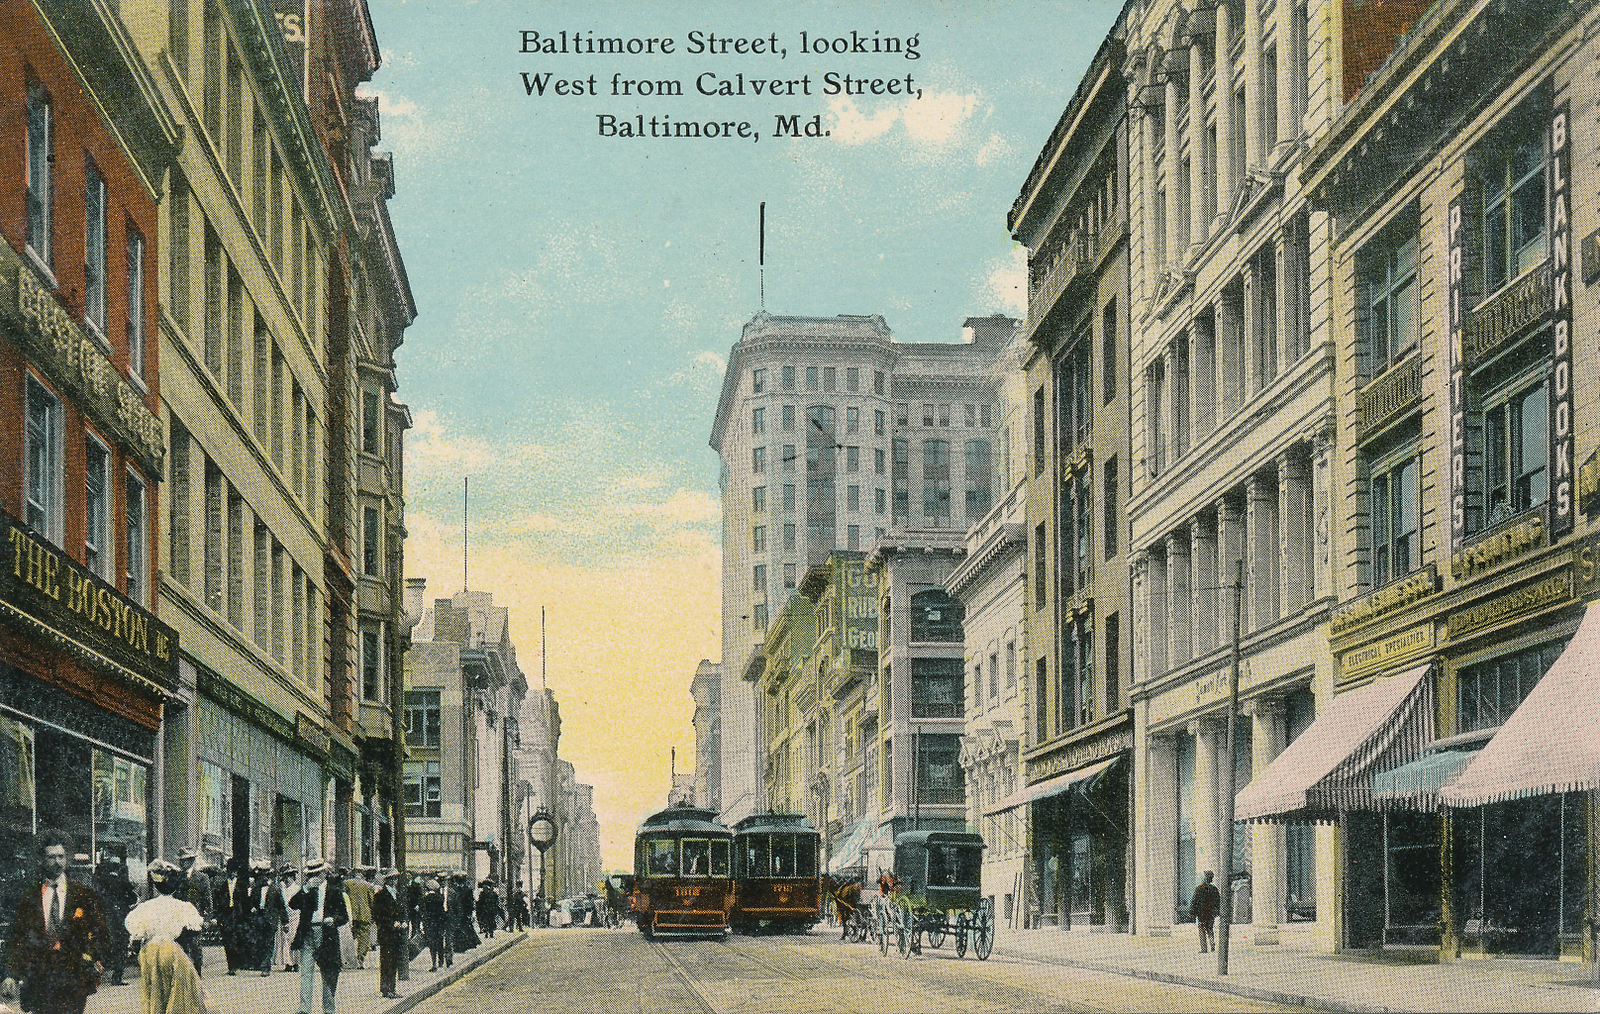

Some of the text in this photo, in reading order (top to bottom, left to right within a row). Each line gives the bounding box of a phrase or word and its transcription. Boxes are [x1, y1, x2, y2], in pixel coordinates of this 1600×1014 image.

[1450, 204, 1464, 530] PRINTERS
[1552, 112, 1571, 516] BLANK BOOKS
[8, 525, 60, 601] THE
[66, 564, 150, 656] BOSTON
